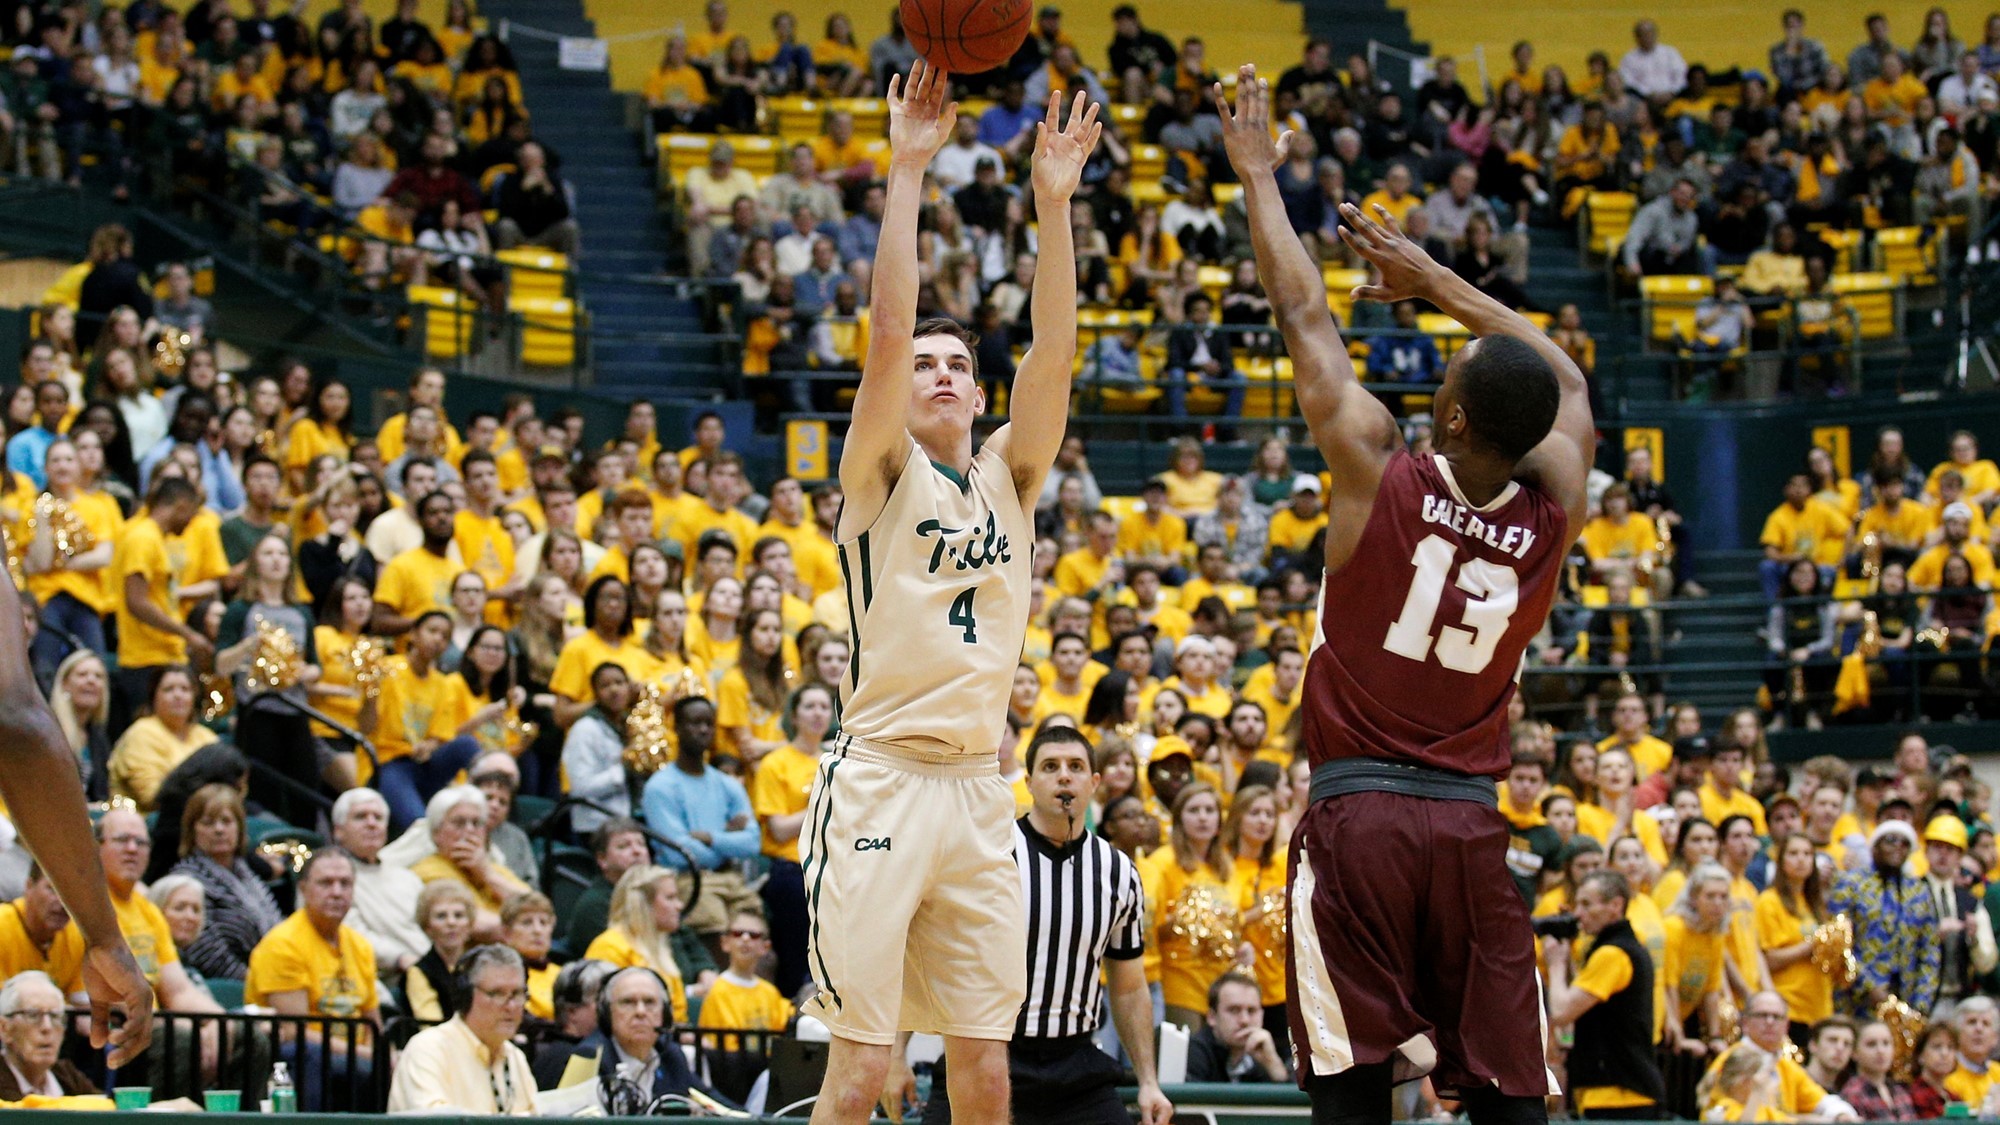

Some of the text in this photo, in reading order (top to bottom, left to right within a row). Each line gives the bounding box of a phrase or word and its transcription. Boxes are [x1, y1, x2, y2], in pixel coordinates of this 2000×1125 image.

[797, 424, 819, 456] 3
[1421, 494, 1536, 560] CHEALEY
[948, 586, 979, 644] 4
[1382, 533, 1520, 675] 13
[854, 836, 892, 852] CAA
